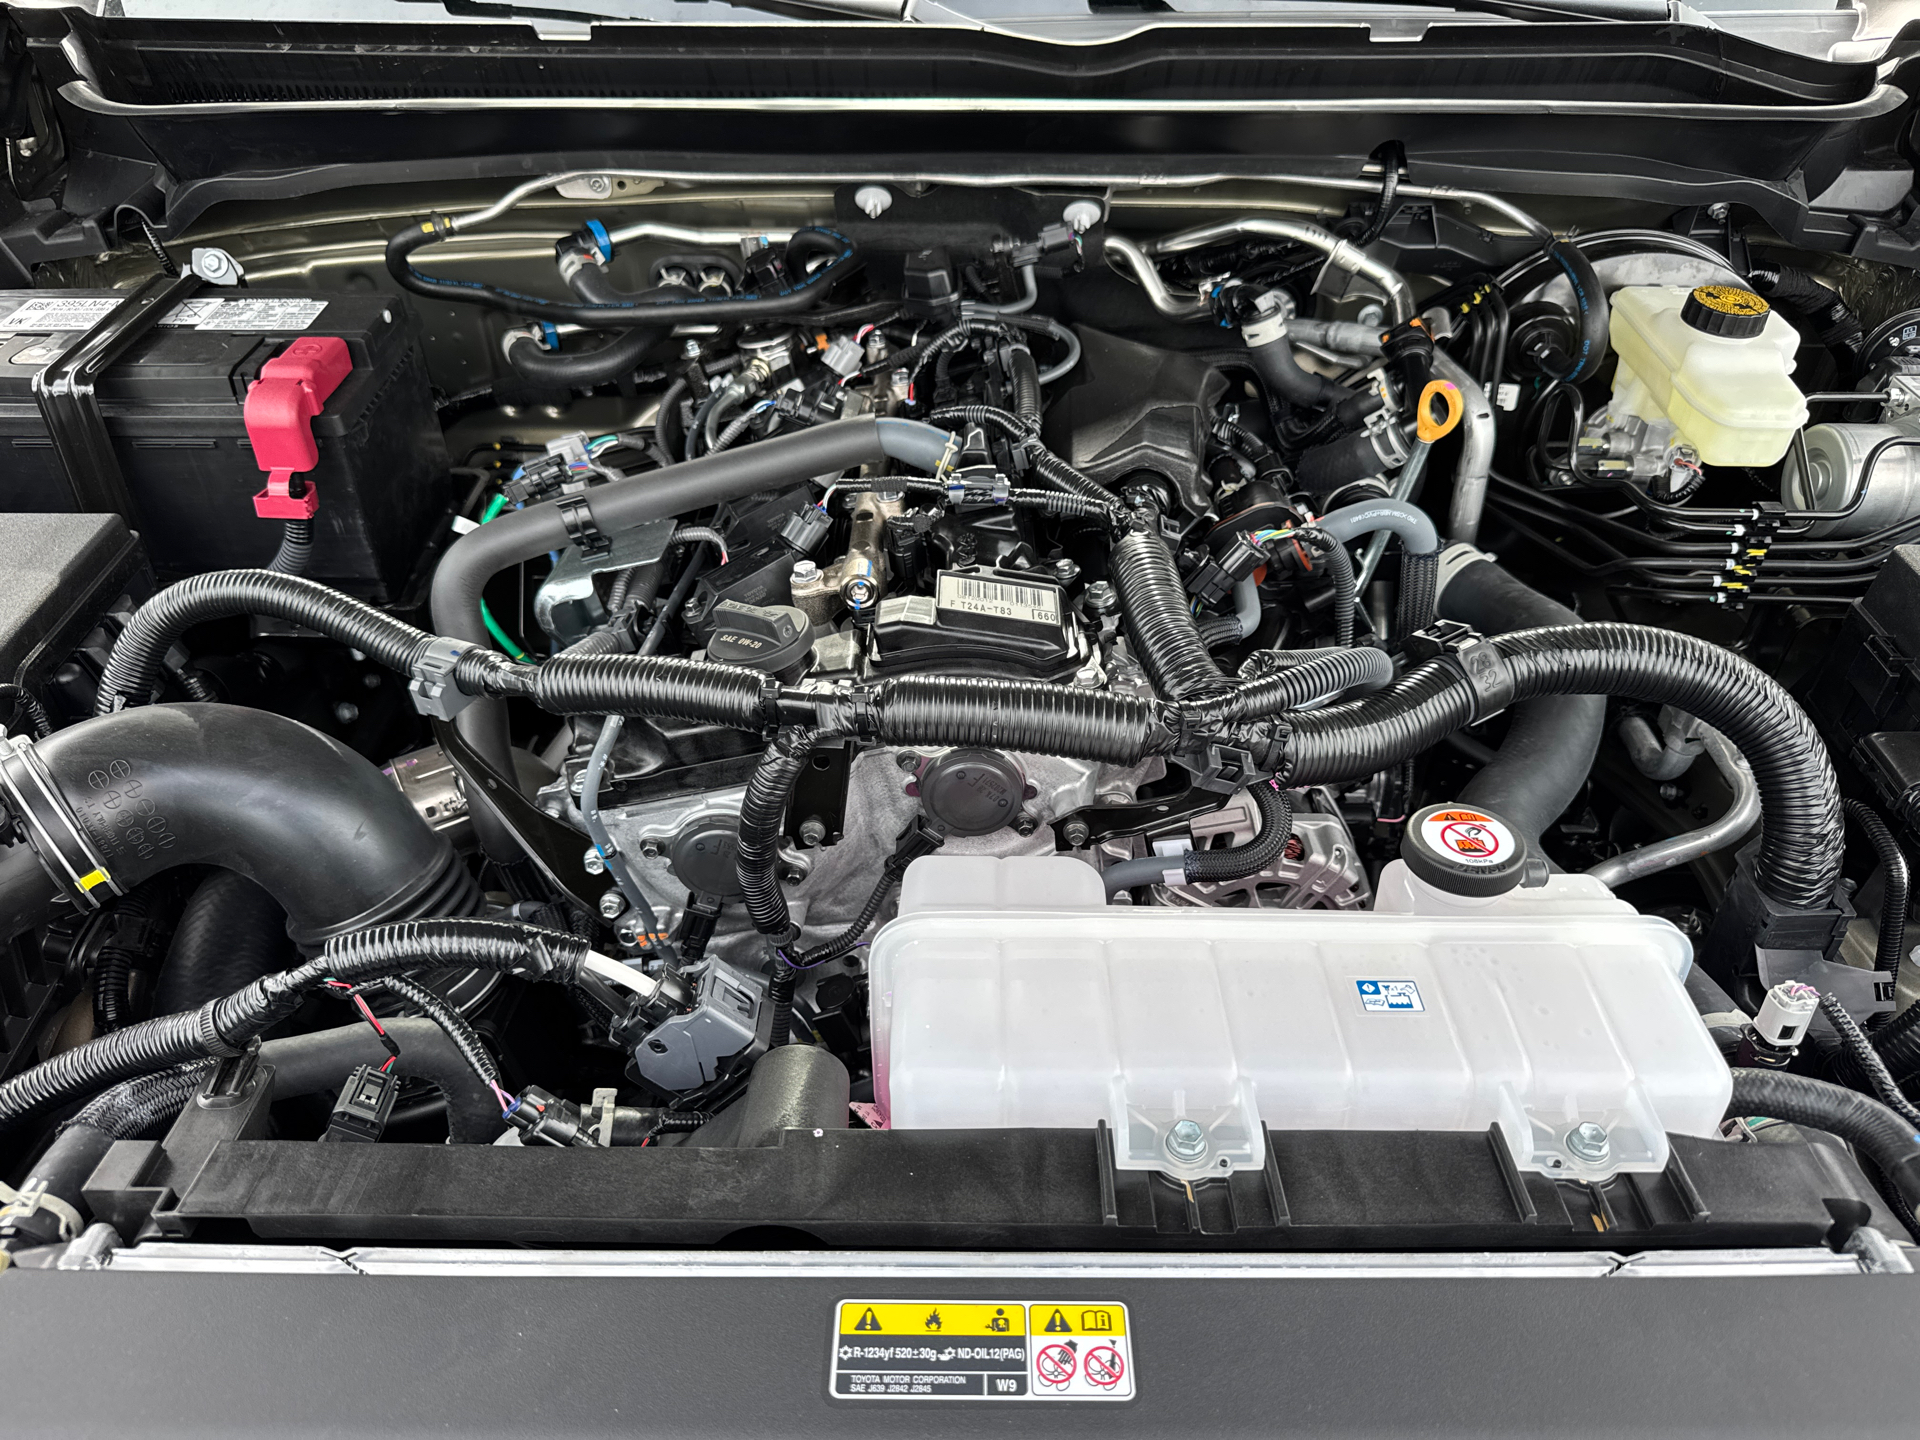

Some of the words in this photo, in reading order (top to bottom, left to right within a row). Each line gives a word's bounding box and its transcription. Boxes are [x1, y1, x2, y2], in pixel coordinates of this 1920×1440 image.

[743, 585, 764, 598] TOYOTA
[961, 601, 1012, 616] T24A-T83
[1037, 612, 1056, 622] 660
[720, 634, 738, 643] SAE
[738, 638, 762, 649] 0W-20
[1479, 668, 1502, 692] 32
[1454, 863, 1508, 875] DENSO
[853, 1347, 894, 1360] R-1234yf
[895, 1347, 937, 1361] 520±30g
[957, 1347, 1025, 1360] ND-OIL12(PAG)
[851, 1375, 880, 1384] TOYOTA
[883, 1375, 910, 1384] MOTOR
[912, 1375, 966, 1384] CORPORATION
[996, 1379, 1017, 1393] W9
[850, 1384, 867, 1392] SAE
[868, 1384, 885, 1392] J639
[887, 1385, 908, 1393] J2842
[911, 1385, 932, 1393] J2845
